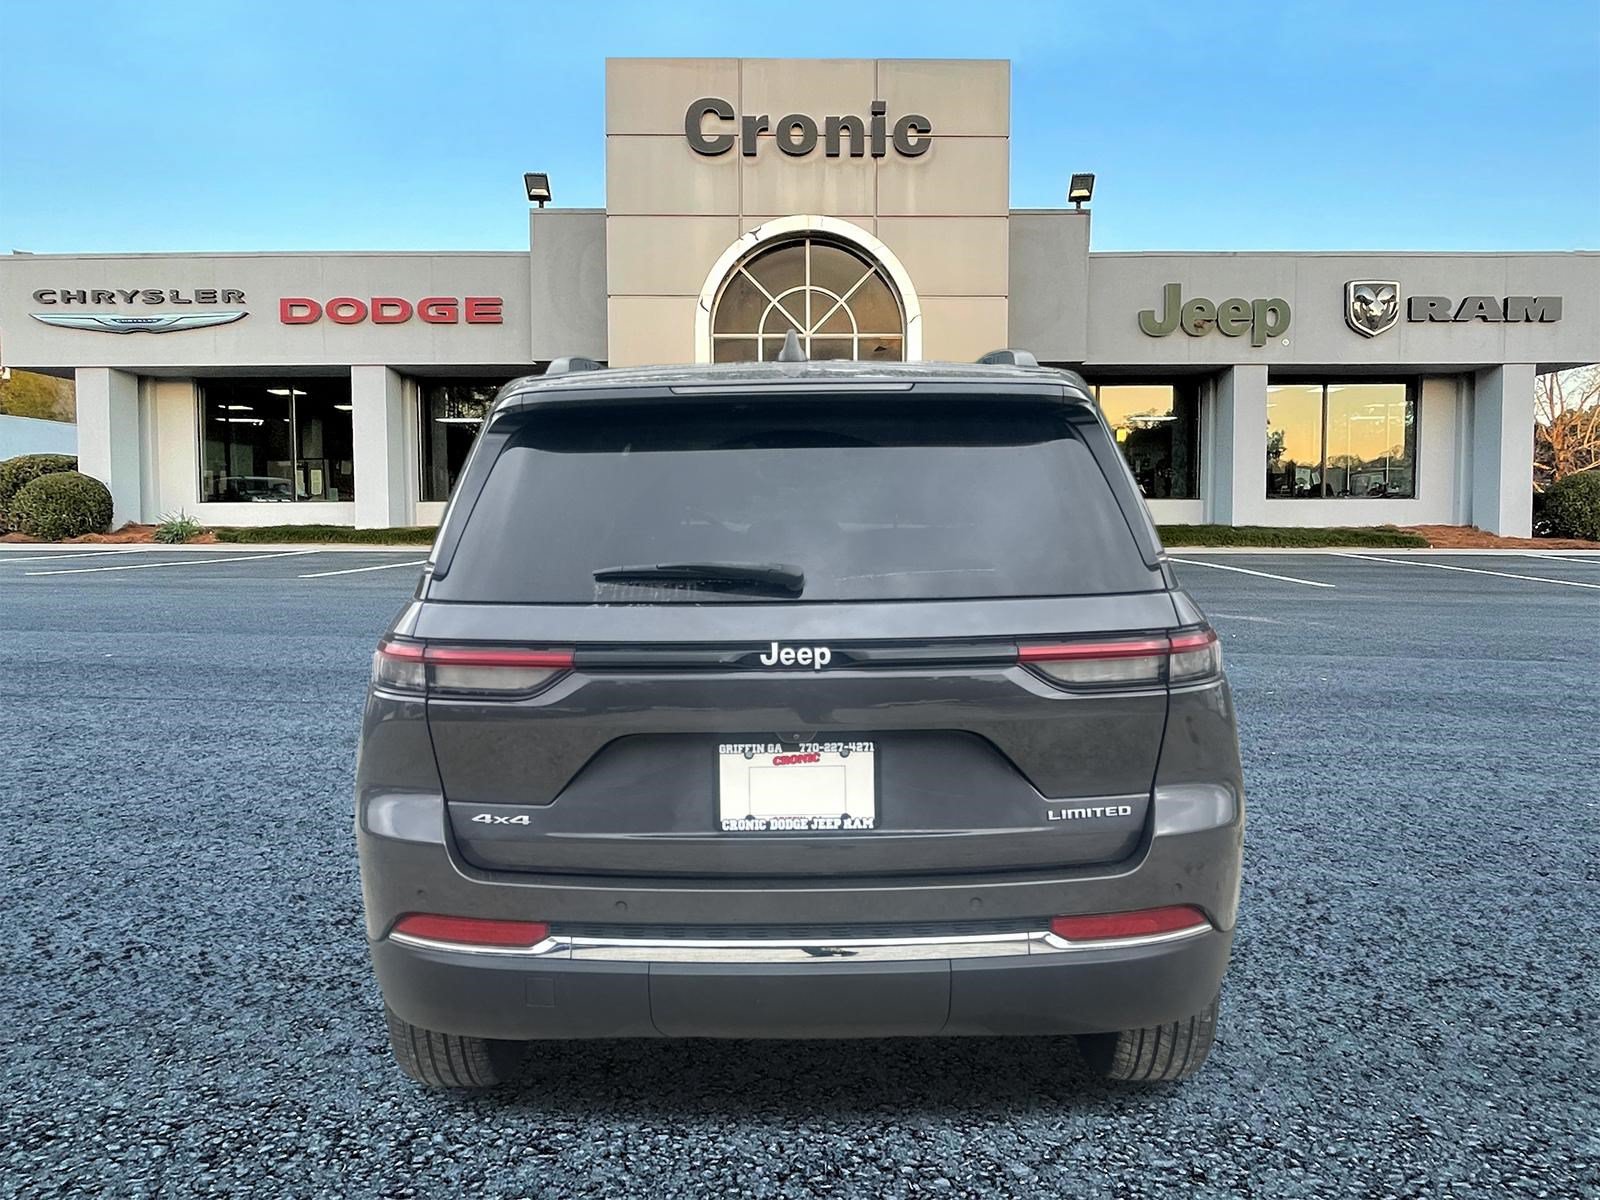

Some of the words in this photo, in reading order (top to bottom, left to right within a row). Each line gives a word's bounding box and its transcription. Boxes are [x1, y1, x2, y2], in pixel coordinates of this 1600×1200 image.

[684, 97, 933, 158] Cronic
[32, 288, 247, 305] CHRYSLER
[279, 296, 504, 325] DODGE
[1138, 283, 1292, 348] Jeep
[1407, 296, 1563, 323] RAM
[760, 641, 832, 670] Jeep
[719, 743, 765, 754] GRIFFIN
[799, 742, 875, 752] 770-227-4271
[471, 813, 531, 825] 4x4
[1047, 805, 1132, 821] LIMITED
[721, 819, 767, 831] CRONIC
[769, 819, 809, 830] DODGE
[810, 818, 842, 830] JEEP
[843, 817, 874, 829] RAM
